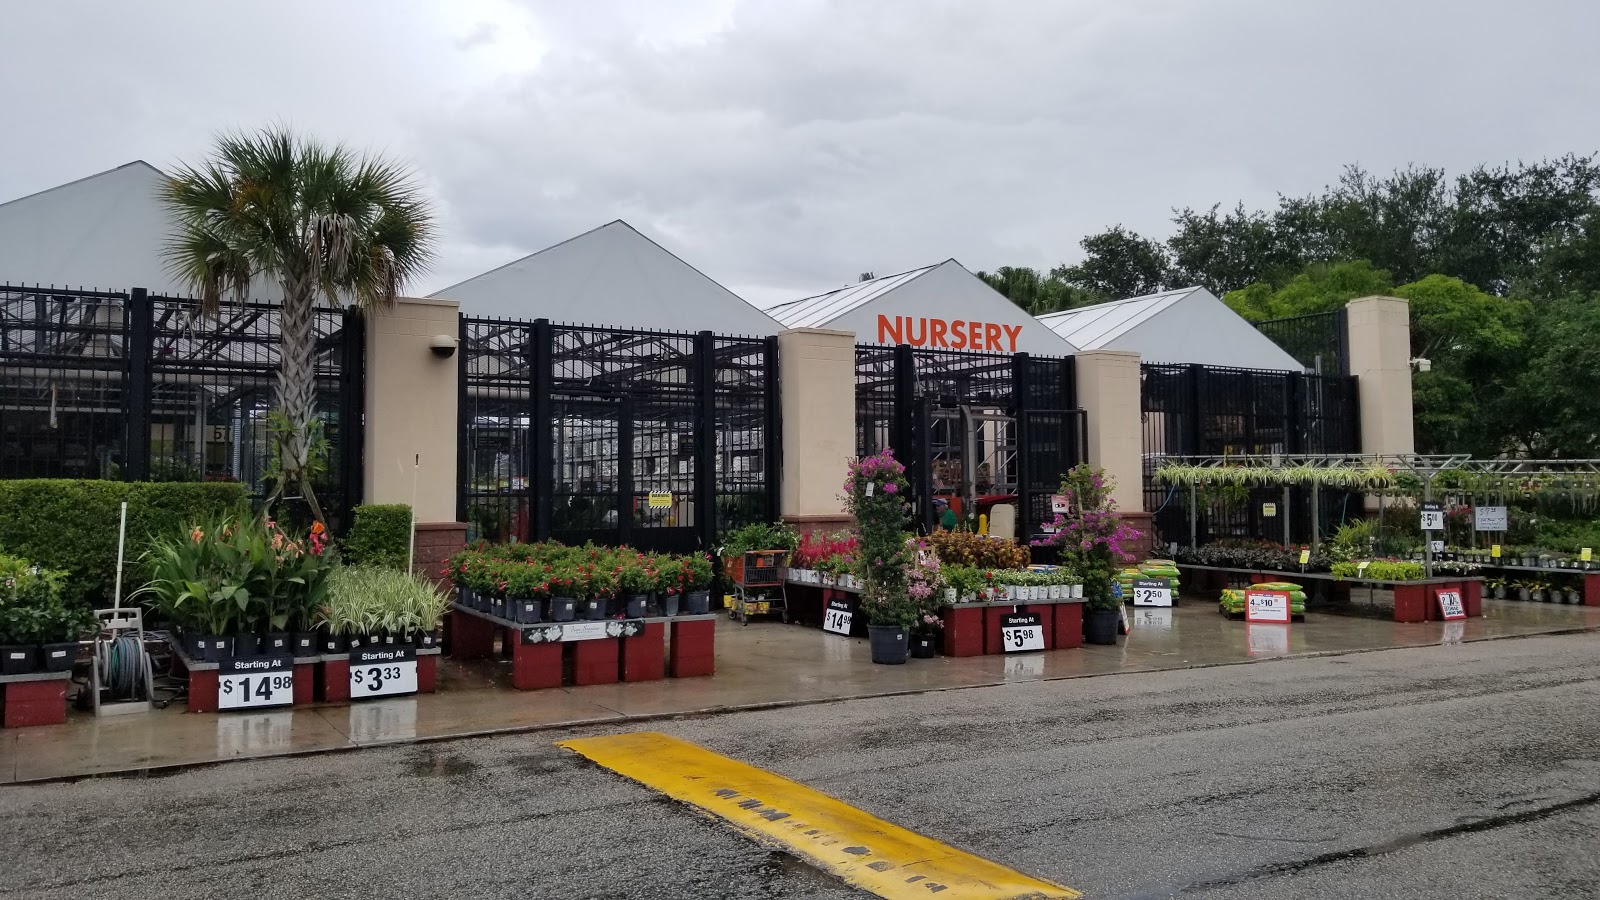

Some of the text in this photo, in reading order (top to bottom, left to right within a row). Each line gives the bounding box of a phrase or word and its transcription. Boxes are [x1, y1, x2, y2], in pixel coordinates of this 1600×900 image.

[878, 314, 1023, 352] NURSERY
[361, 650, 405, 660] Starting At
[234, 659, 282, 670] Starting At
